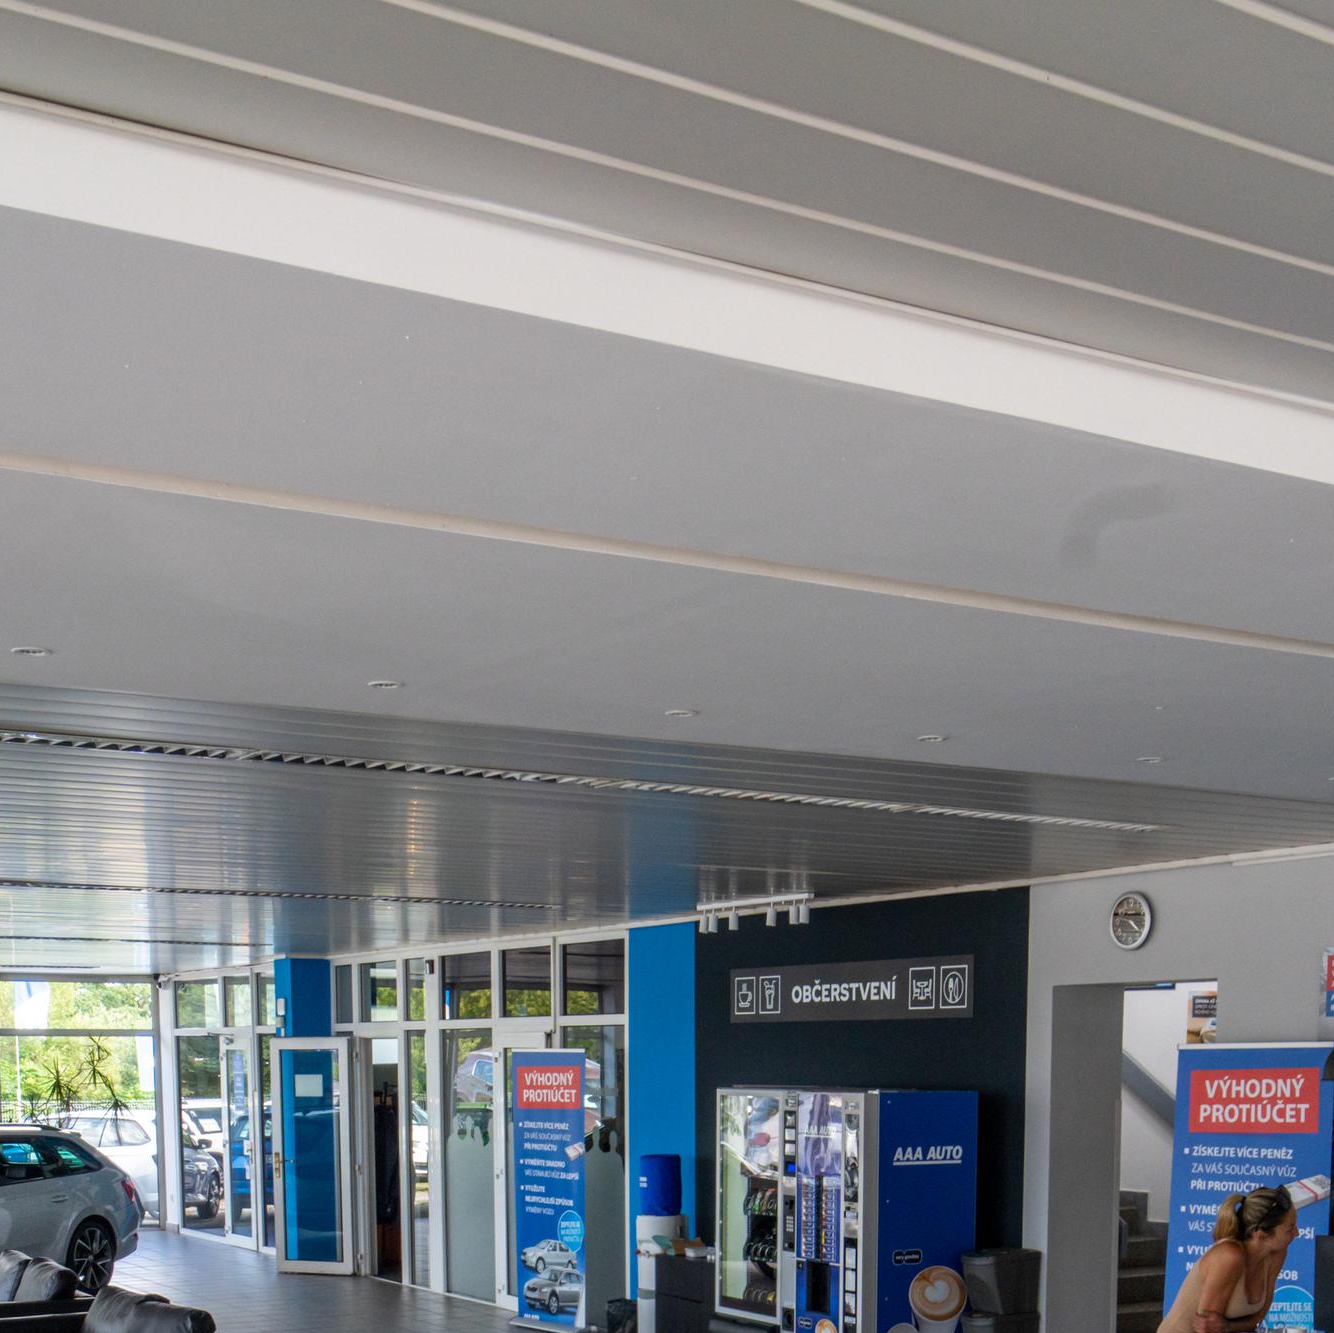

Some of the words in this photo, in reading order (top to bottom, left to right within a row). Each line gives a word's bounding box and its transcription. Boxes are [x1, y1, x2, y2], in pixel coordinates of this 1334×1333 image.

[791, 975, 897, 1004] OBČERSTVENÍ
[524, 1070, 574, 1086] VÝHODNÝ
[1205, 1074, 1305, 1099] VÝHODNÝ
[523, 1087, 576, 1103] PROTIÚČET
[1199, 1100, 1310, 1124] PROTIÚČET
[893, 1146, 923, 1161] AAA
[927, 1145, 963, 1160] AUTO
[1192, 1145, 1235, 1158] ZÍSKEJTE
[1236, 1146, 1259, 1159] VÍCE
[1261, 1147, 1293, 1160] PENĚZ
[1191, 1164, 1204, 1174] ZA
[1205, 1162, 1223, 1175] VÁŠ
[1225, 1164, 1277, 1177] SOUČASNÝ
[1278, 1165, 1297, 1178] VŮZ
[1190, 1178, 1206, 1191] PŘI
[1188, 1220, 1206, 1232] VÁŠ
[1298, 1226, 1315, 1239] PŠÍ
